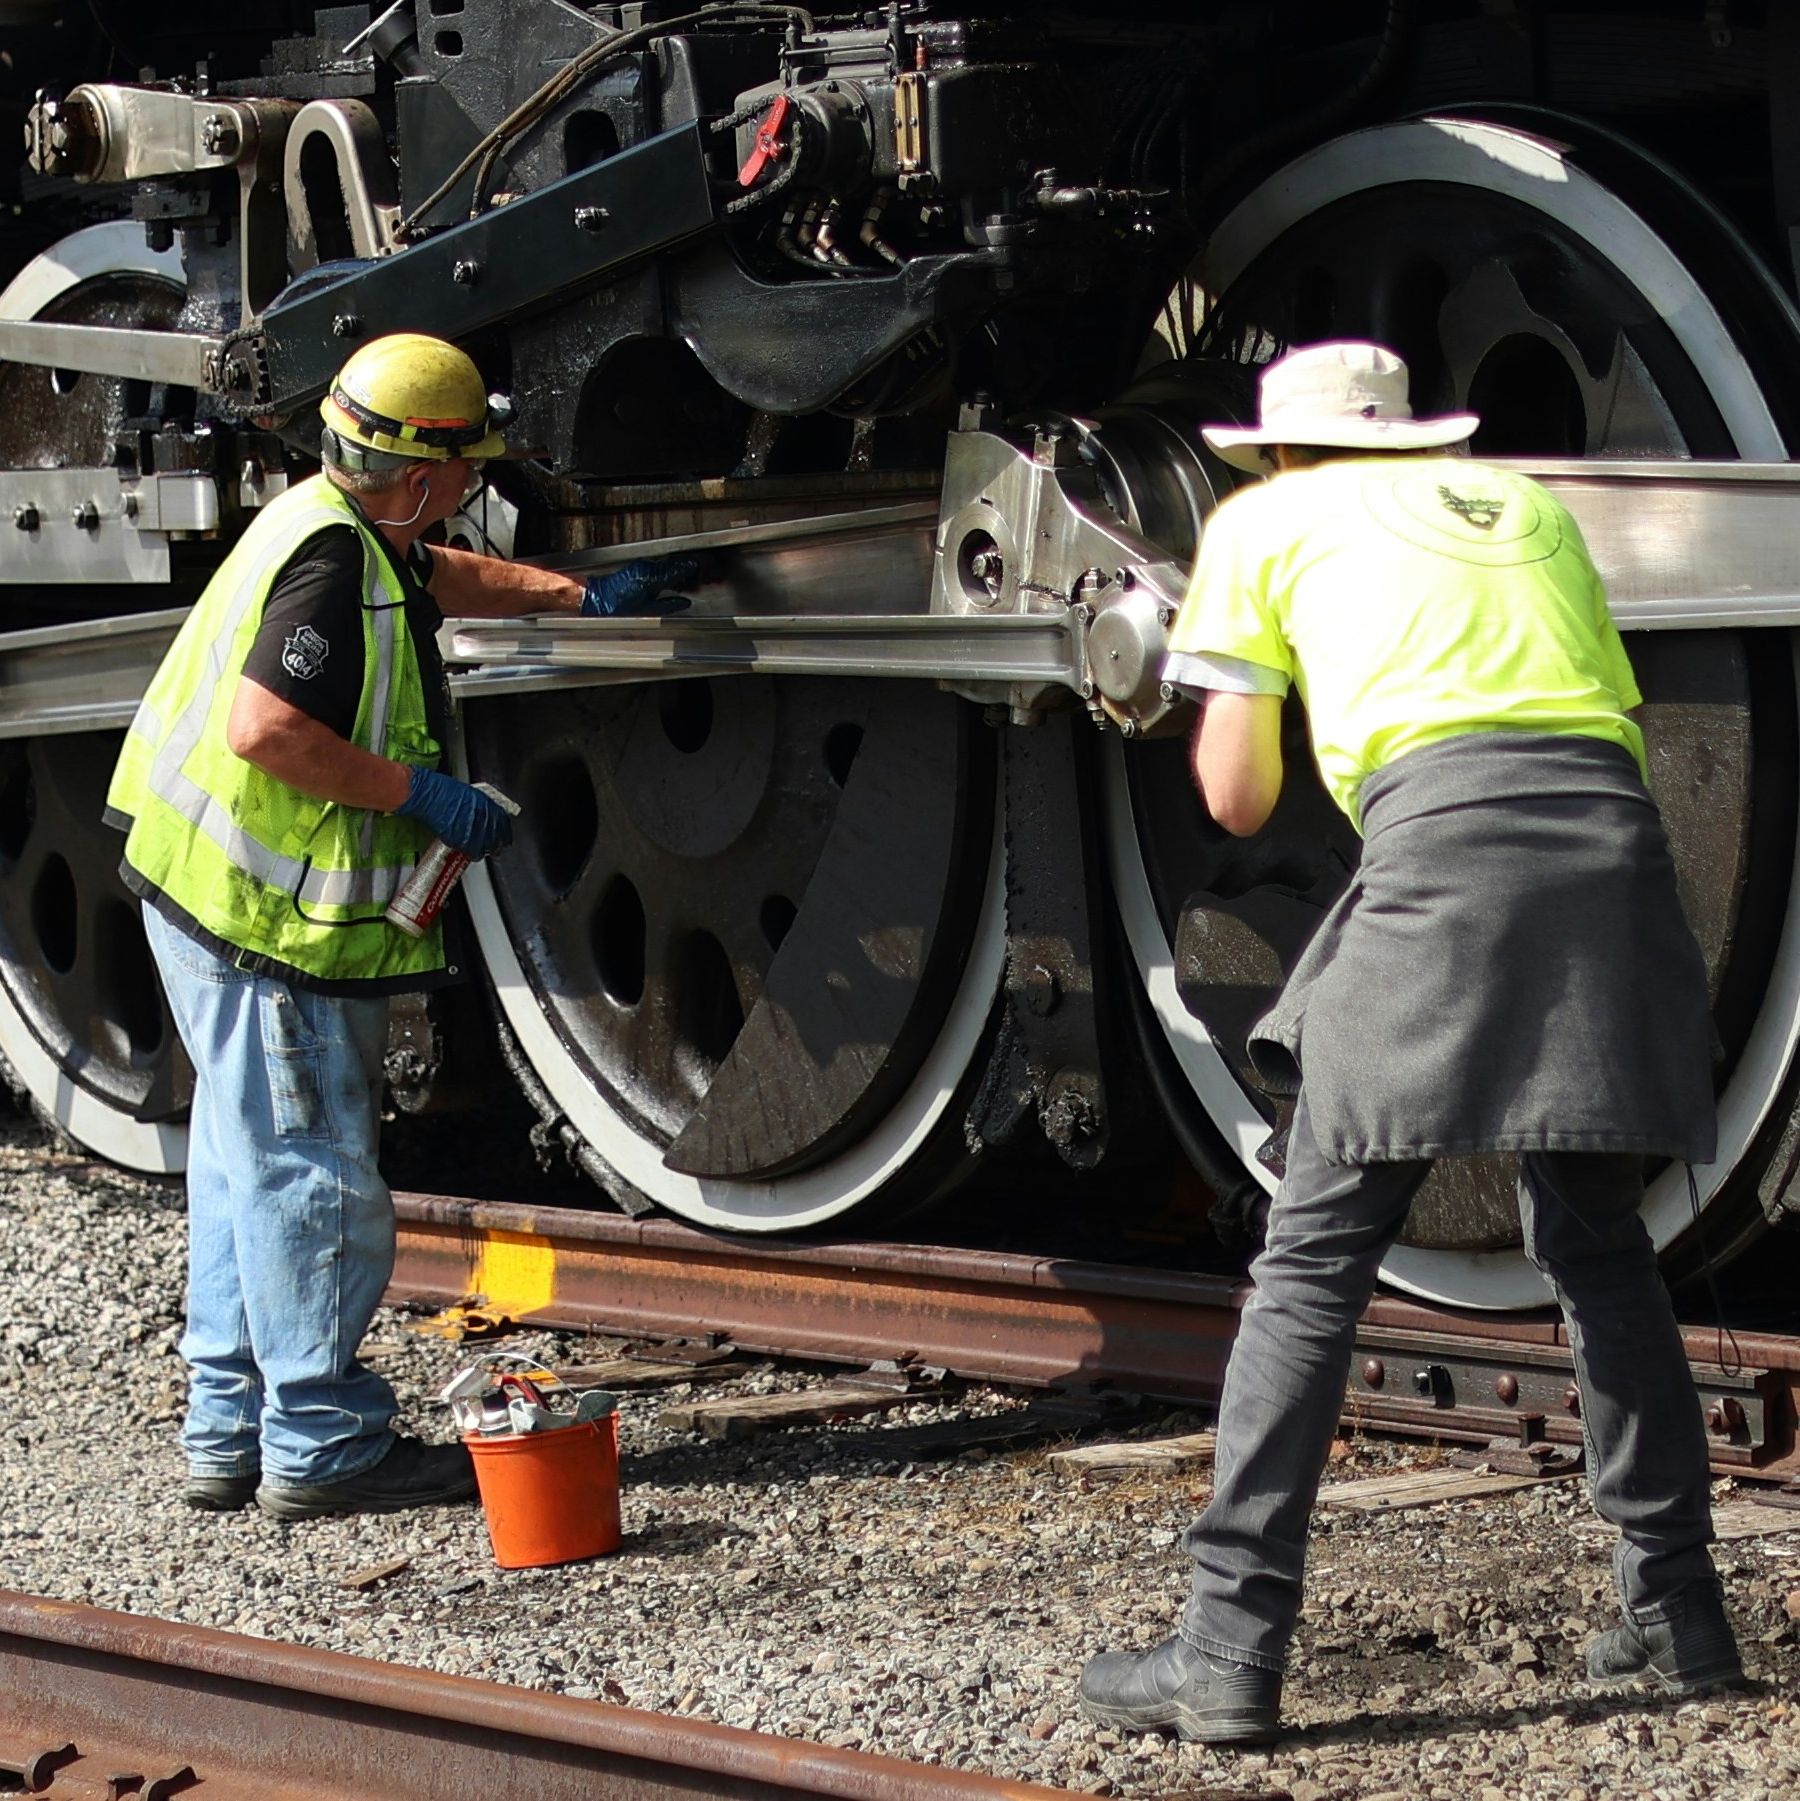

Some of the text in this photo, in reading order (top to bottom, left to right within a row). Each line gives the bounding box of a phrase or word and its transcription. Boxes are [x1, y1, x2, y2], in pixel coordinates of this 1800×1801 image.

[300, 635, 321, 656] PACIFIC
[304, 630, 325, 650] UNION
[287, 653, 312, 676] 4014
[427, 854, 463, 913] CORROSIO
